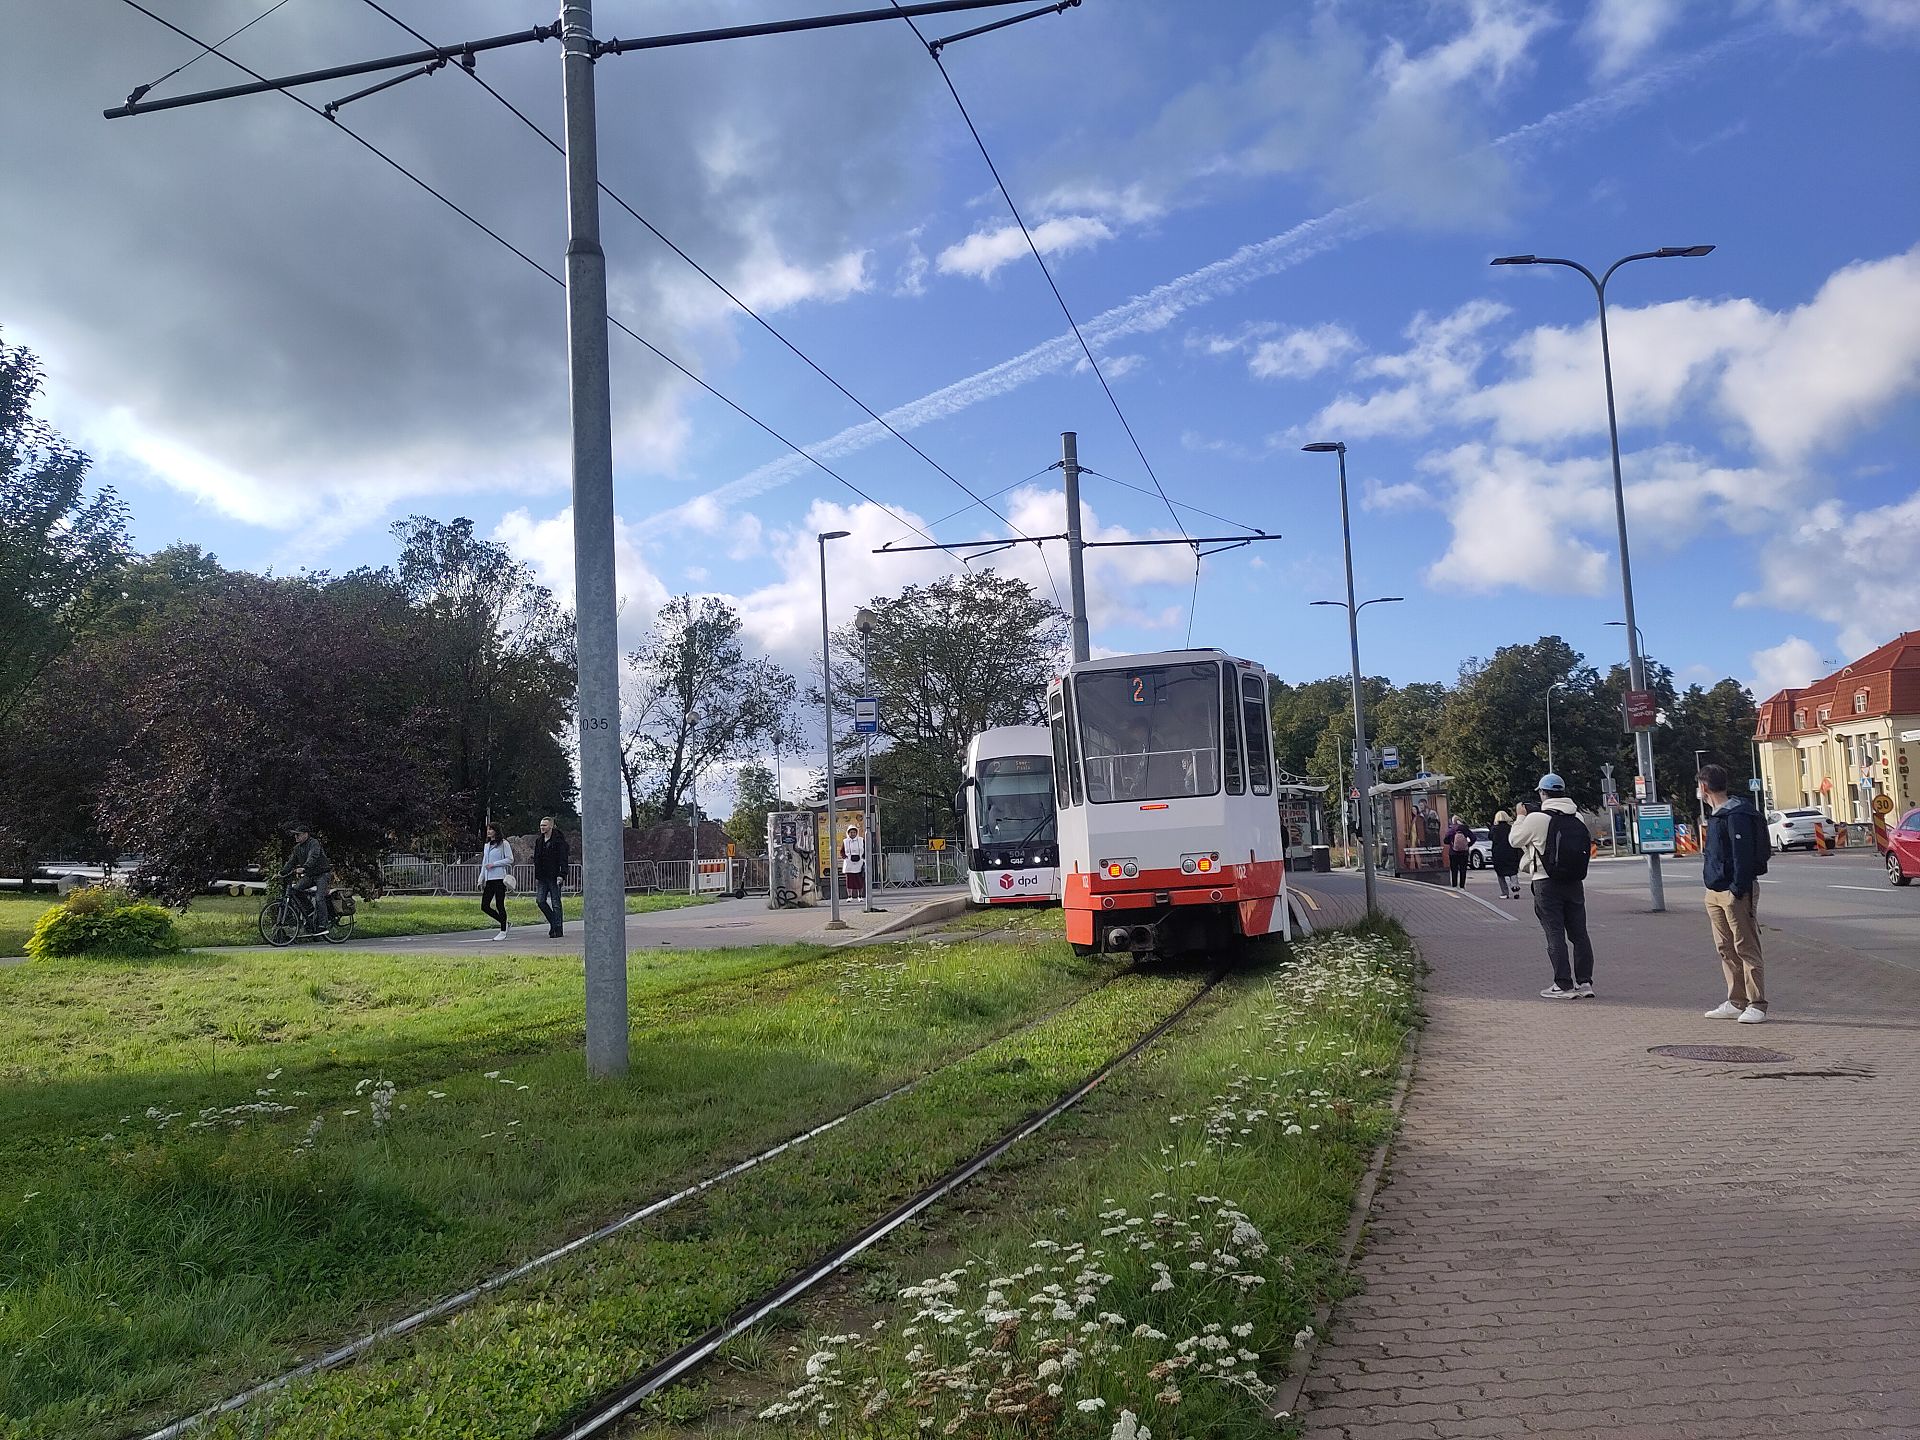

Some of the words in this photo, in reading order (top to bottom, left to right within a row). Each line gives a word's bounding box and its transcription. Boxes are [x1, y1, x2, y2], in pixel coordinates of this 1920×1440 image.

[1132, 677, 1144, 702] 2
[993, 761, 1001, 773] 2
[1876, 800, 1889, 810] 30
[1010, 850, 1025, 858] 504
[1018, 874, 1038, 888] dpd
